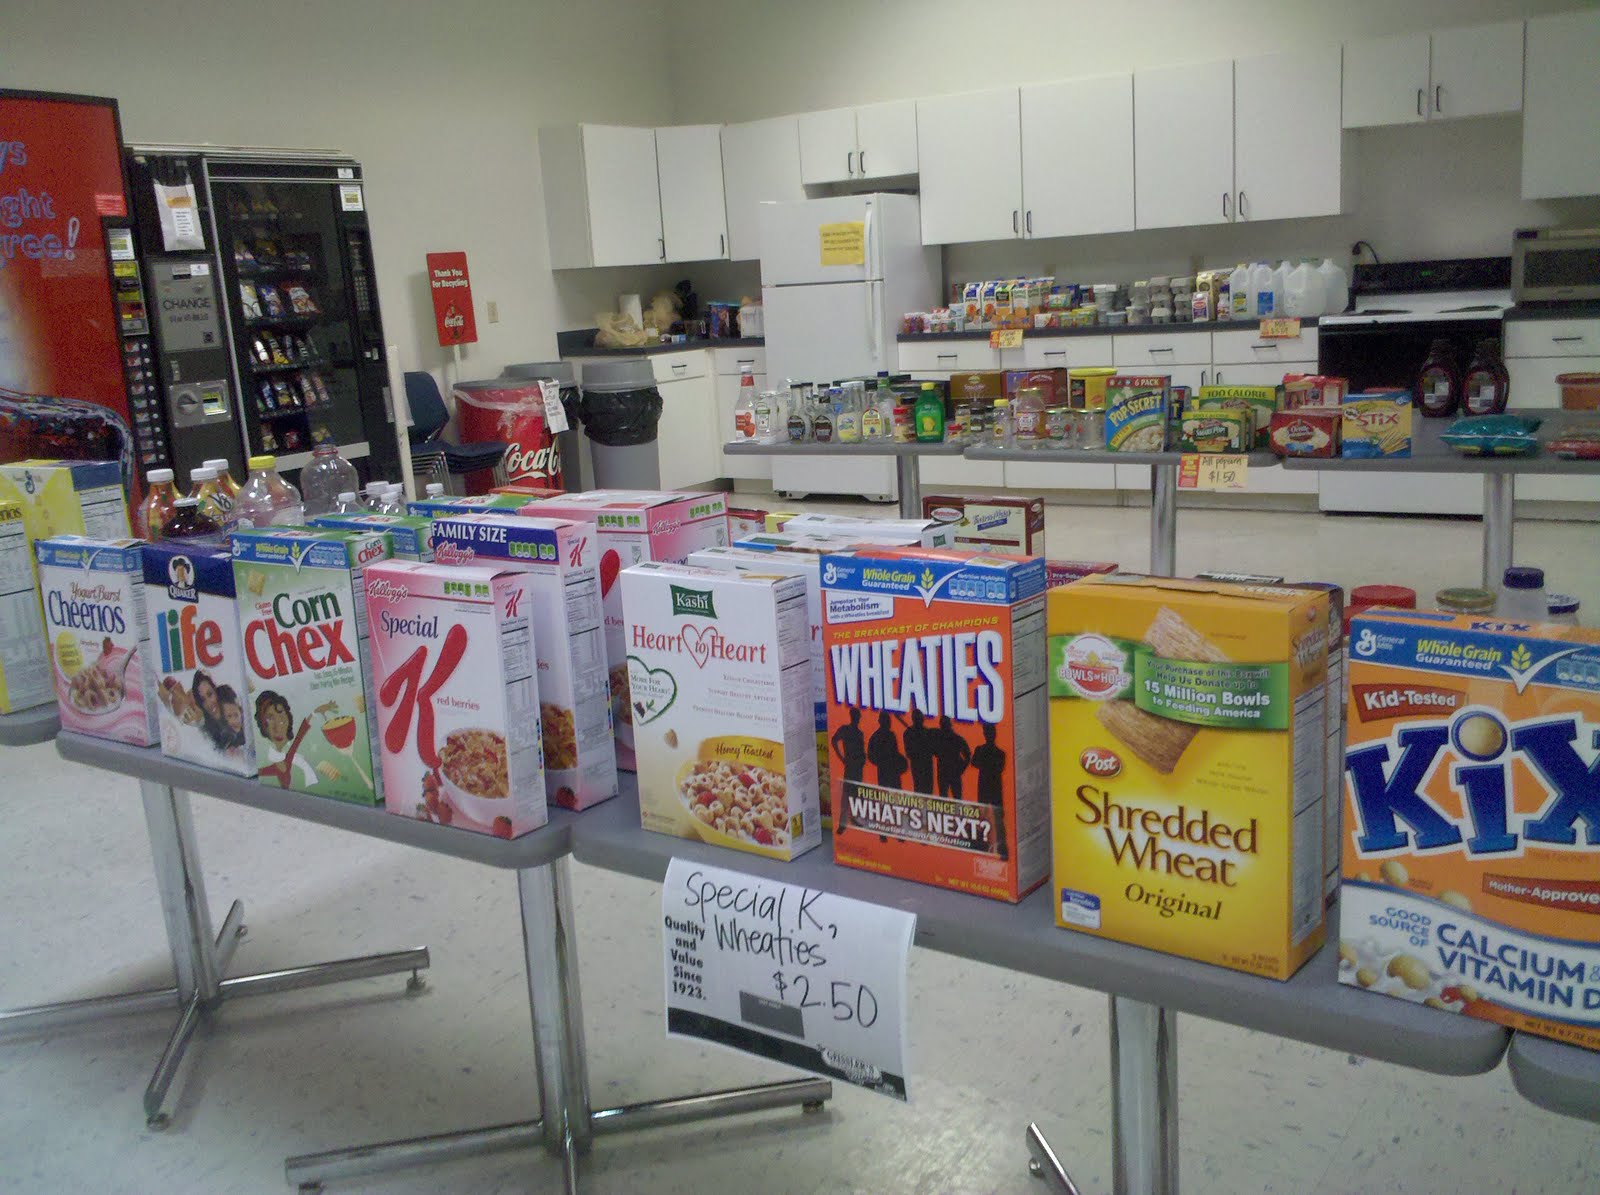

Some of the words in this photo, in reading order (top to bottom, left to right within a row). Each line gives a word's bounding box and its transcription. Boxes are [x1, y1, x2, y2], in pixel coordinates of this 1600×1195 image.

[163, 297, 211, 310] CHANGE
[1134, 378, 1140, 387] 6
[1140, 378, 1160, 386] PACK
[1207, 389, 1226, 398] 100
[1227, 388, 1267, 399] CALORIE
[1215, 457, 1242, 470] popcorn
[208, 492, 232, 512] V8
[432, 522, 477, 541] FAMILY
[479, 526, 507, 543] SIZE
[358, 544, 384, 564] Chex
[365, 538, 382, 549] Corn
[435, 540, 475, 565] Kellogg's
[861, 579, 910, 591] Guaranteed
[863, 568, 890, 583] Whole
[891, 571, 916, 584] Grain
[70, 582, 97, 601] Yogurt
[169, 583, 197, 600] QUAKER
[368, 579, 408, 604] Kellogg's
[675, 592, 709, 610] Kashi
[48, 590, 126, 634] Cheerios
[272, 592, 342, 629] Corn
[829, 602, 879, 614] Metabolism
[380, 610, 439, 639] Special
[833, 631, 850, 640] THE
[854, 624, 912, 639] BREAKFAST
[915, 623, 929, 632] OF
[932, 616, 1000, 631] CHAMPIONS
[156, 604, 224, 674] life
[244, 618, 357, 681] Chex
[632, 624, 682, 653] Heart
[695, 640, 706, 654] to
[711, 635, 767, 665] Heart
[1417, 639, 1462, 657] Whole
[1462, 644, 1503, 662] Grain
[1147, 660, 1164, 671] Your
[1165, 663, 1203, 676] Purchase
[1206, 668, 1216, 677] of
[1415, 653, 1493, 671] Guaranteed
[830, 629, 1005, 725] WHEATIES
[1059, 668, 1094, 682] BOWLS
[1101, 672, 1129, 687] HOPE
[1156, 672, 1178, 685] Help
[1179, 675, 1192, 685] Us
[1195, 676, 1229, 688] Donate
[1232, 680, 1245, 690] up
[379, 623, 468, 770] K
[1144, 680, 1160, 694] 15
[1164, 685, 1217, 704] Million
[1222, 691, 1271, 707] Bowls
[1363, 690, 1457, 711] Kid-Tested
[436, 697, 449, 706] red
[451, 698, 480, 712] berries
[1153, 696, 1164, 706] to
[1166, 700, 1210, 717] Feeding
[1214, 707, 1261, 719] America
[715, 742, 741, 758] Honey
[741, 743, 775, 760] Toasted
[1084, 752, 1117, 772] Post
[857, 787, 895, 802] FUELING
[898, 796, 924, 810] WINS
[926, 800, 957, 815] SINCE
[958, 803, 981, 819] 1924
[848, 796, 923, 831] WHAT'S
[927, 811, 991, 842] NEXT?
[1075, 784, 1259, 855] Shredded
[1104, 826, 1238, 888] Wheat
[684, 871, 786, 928] Special
[1124, 882, 1223, 921] Original
[1369, 914, 1430, 939] SOURCE
[1385, 906, 1432, 927] GOOD
[664, 915, 705, 941] Quality
[675, 937, 697, 951] and
[714, 913, 827, 967] Wheaties
[1409, 935, 1430, 949] OF
[670, 948, 704, 968] Value
[1436, 923, 1586, 984] CALCIUM
[673, 965, 703, 984] Since
[1437, 946, 1576, 1008] VITAMIN
